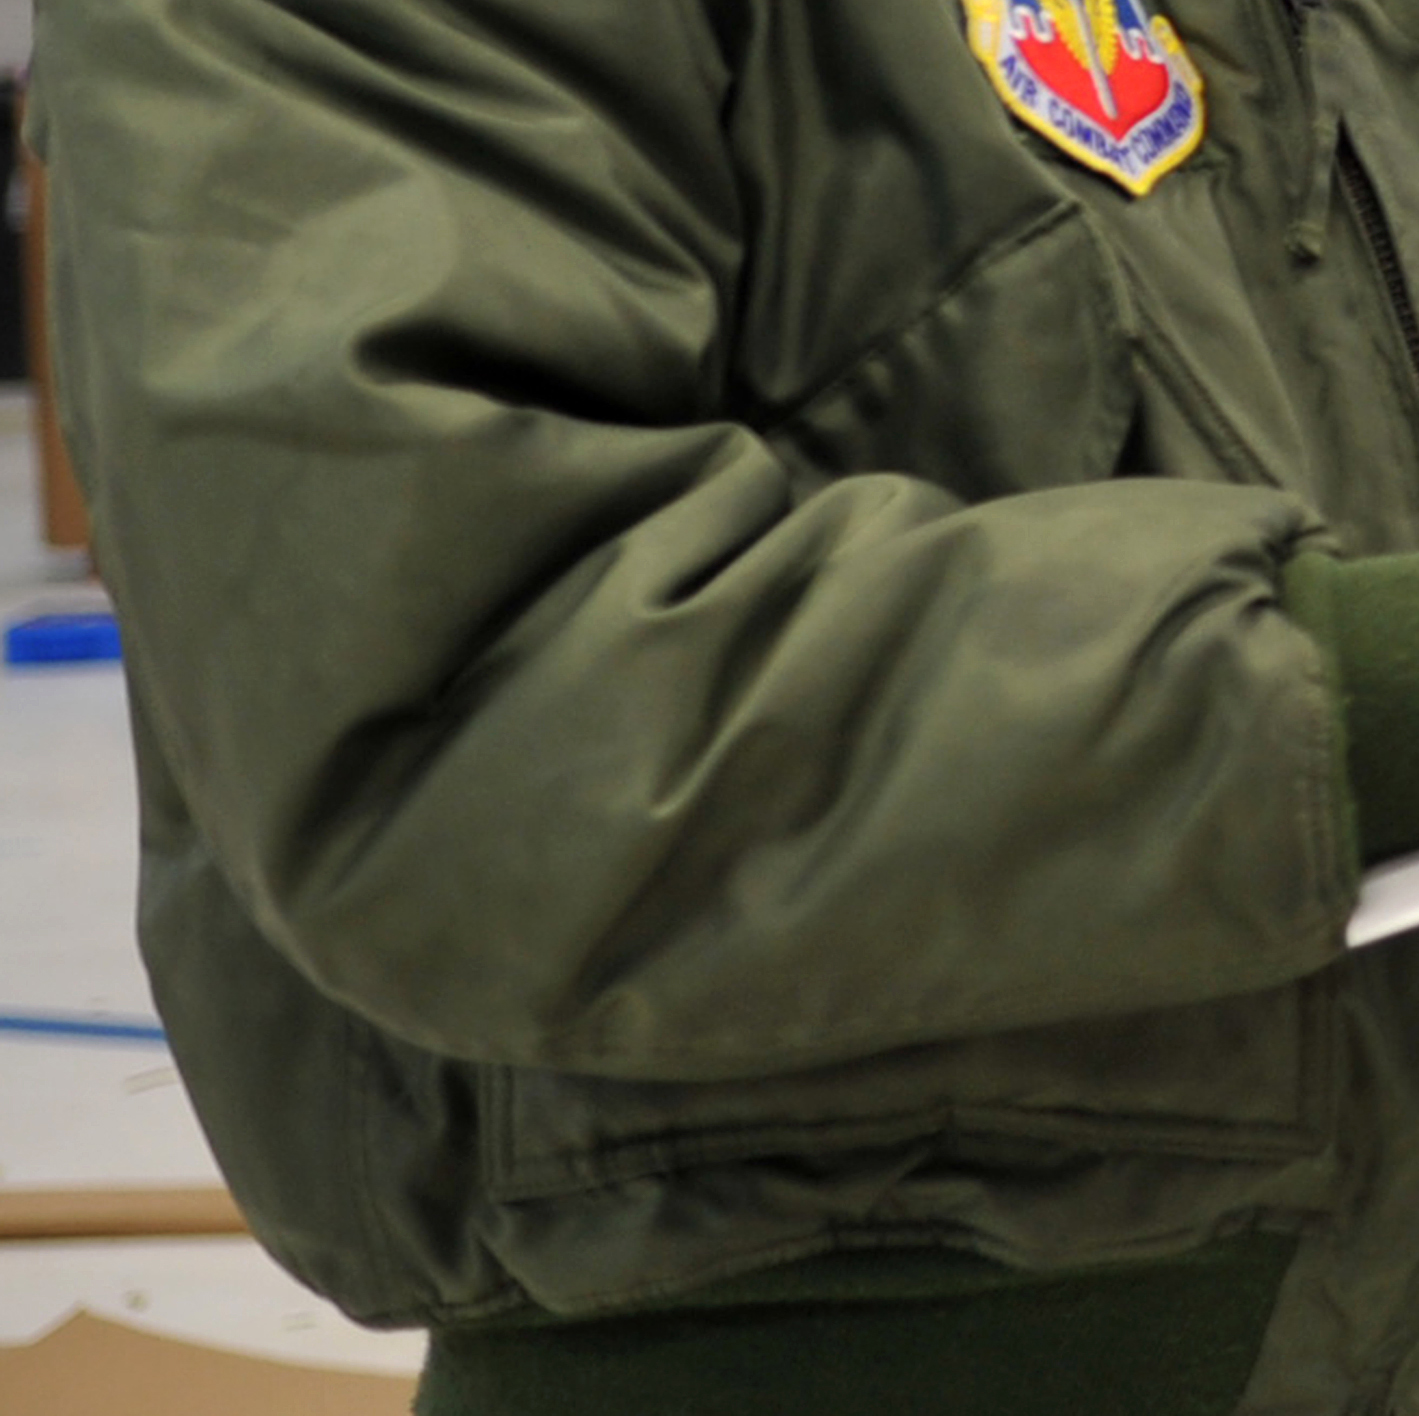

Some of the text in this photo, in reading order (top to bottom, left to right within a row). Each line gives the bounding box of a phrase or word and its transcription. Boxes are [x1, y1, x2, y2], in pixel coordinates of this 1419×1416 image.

[1000, 54, 1192, 174] AIR COMBAT COMMAND
